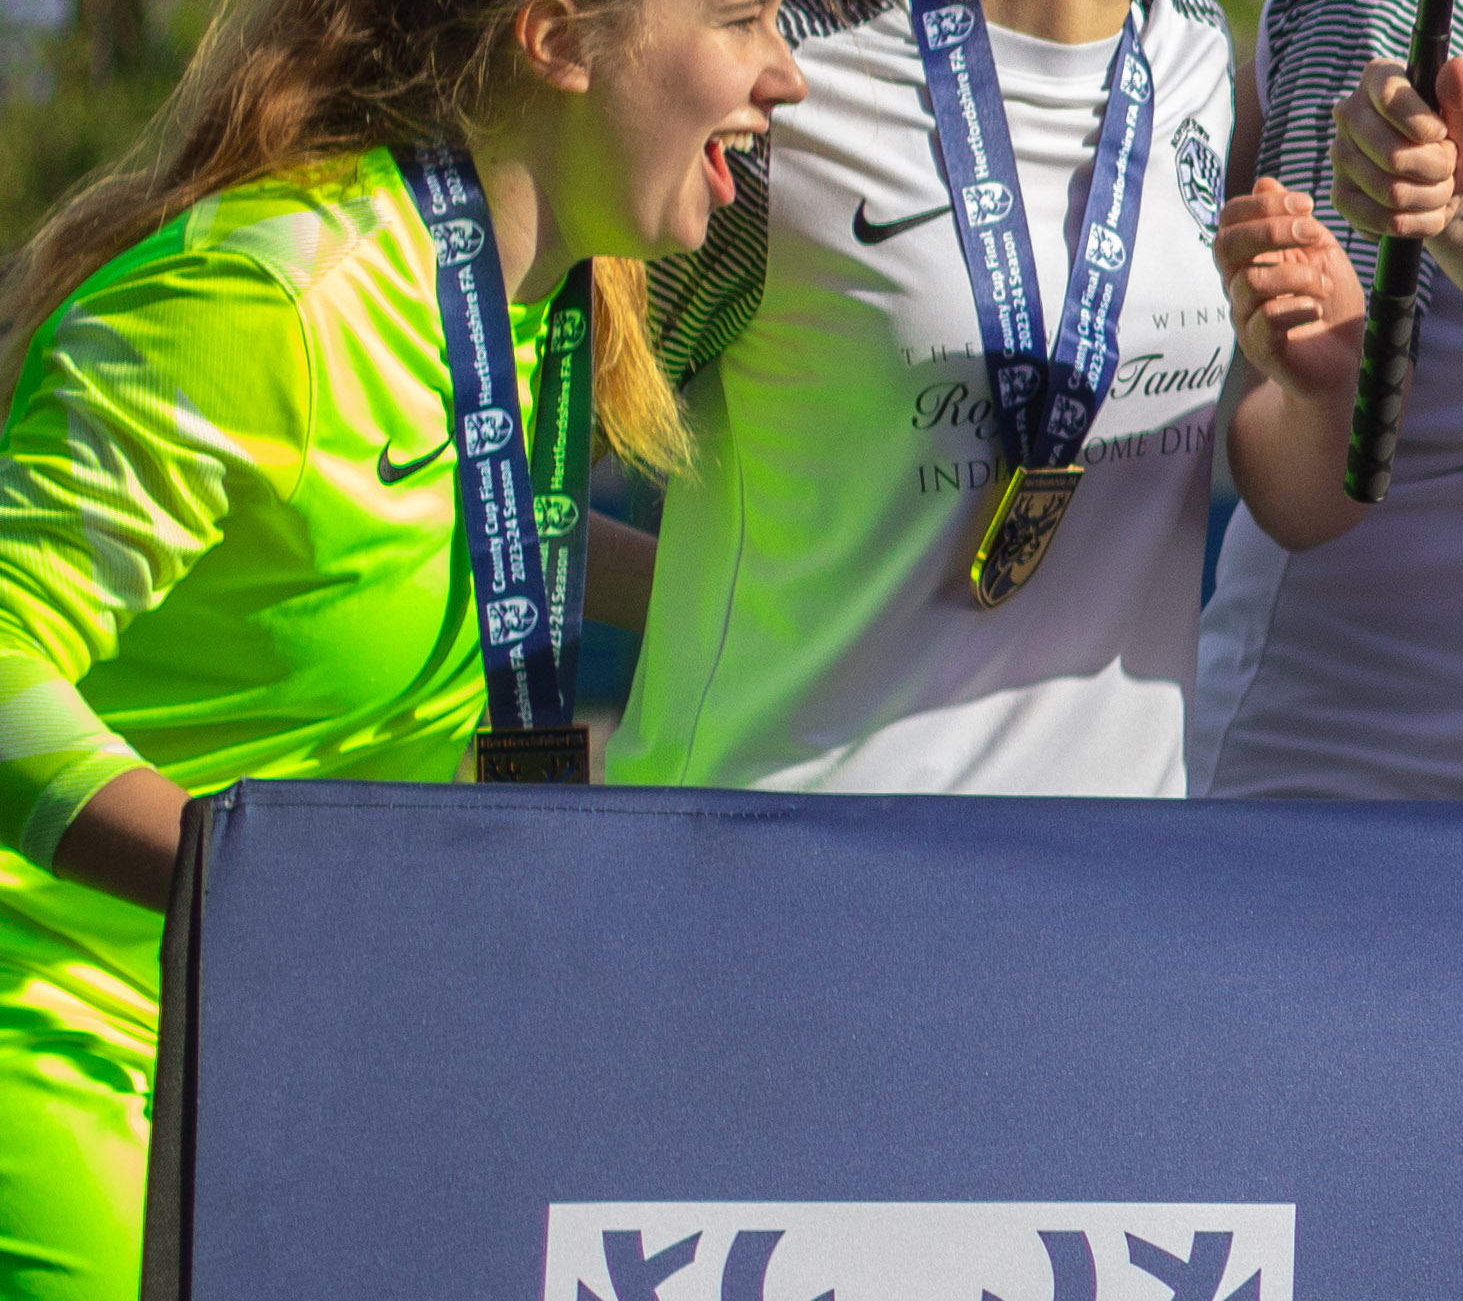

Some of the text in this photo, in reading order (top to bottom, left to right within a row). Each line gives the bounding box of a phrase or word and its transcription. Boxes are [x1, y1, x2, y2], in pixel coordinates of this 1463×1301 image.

[949, 45, 989, 180] Hertfordshire FA
[1107, 104, 1140, 229] Hertfordshire FA
[979, 230, 1015, 359] County Cup Final
[1003, 231, 1033, 352] 2023-24 Season
[1077, 297, 1093, 333] Cup
[1082, 269, 1101, 304] Final
[1152, 306, 1226, 330] WINN
[458, 264, 493, 407] Hertfordshire FA
[901, 342, 975, 366] THE
[1110, 346, 1226, 400] Tando
[551, 353, 573, 491] Hertfordshire FA
[1082, 424, 1212, 465] OME DIN
[919, 457, 998, 492] INDI
[476, 458, 506, 594] County Cup Final
[500, 460, 525, 583] 2023-24 Season
[551, 547, 569, 603] Season
[509, 643, 534, 730] rdshire FA
